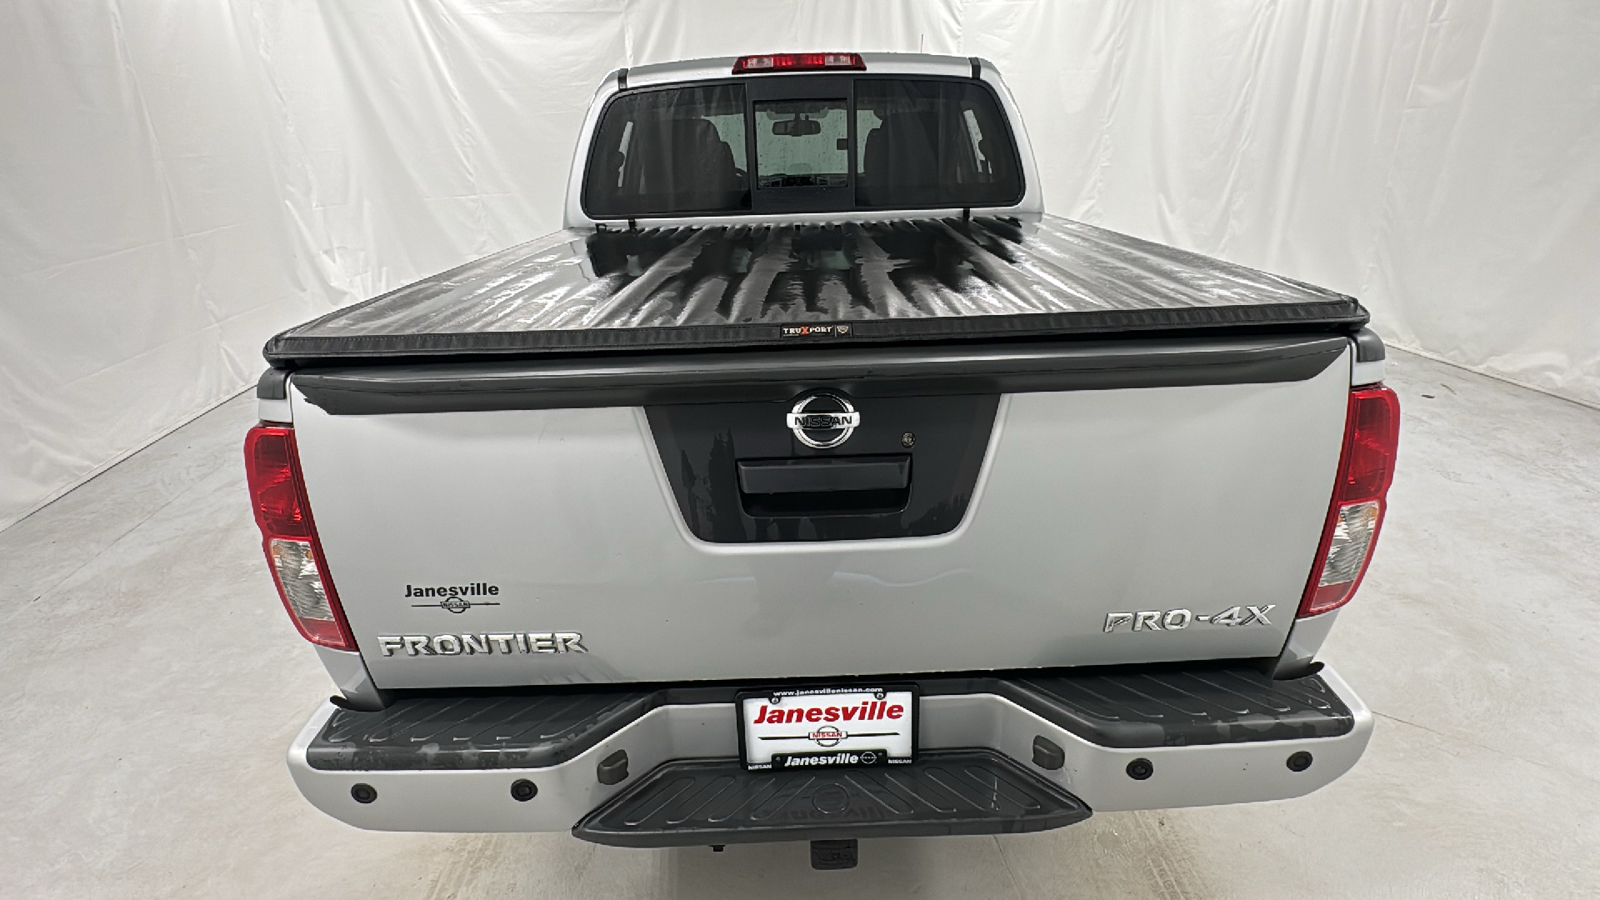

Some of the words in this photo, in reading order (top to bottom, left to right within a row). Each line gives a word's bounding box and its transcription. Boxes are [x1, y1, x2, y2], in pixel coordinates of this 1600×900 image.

[783, 325, 833, 335] TRUXPORT
[794, 415, 853, 427] NISSAN
[404, 582, 500, 598] Janesville
[1103, 604, 1276, 633] PRO-4X
[377, 631, 589, 657] FRONTIER
[773, 688, 883, 696] www.janesvillenissan.com
[753, 701, 904, 724] Janesville
[784, 752, 859, 767] Janesville
